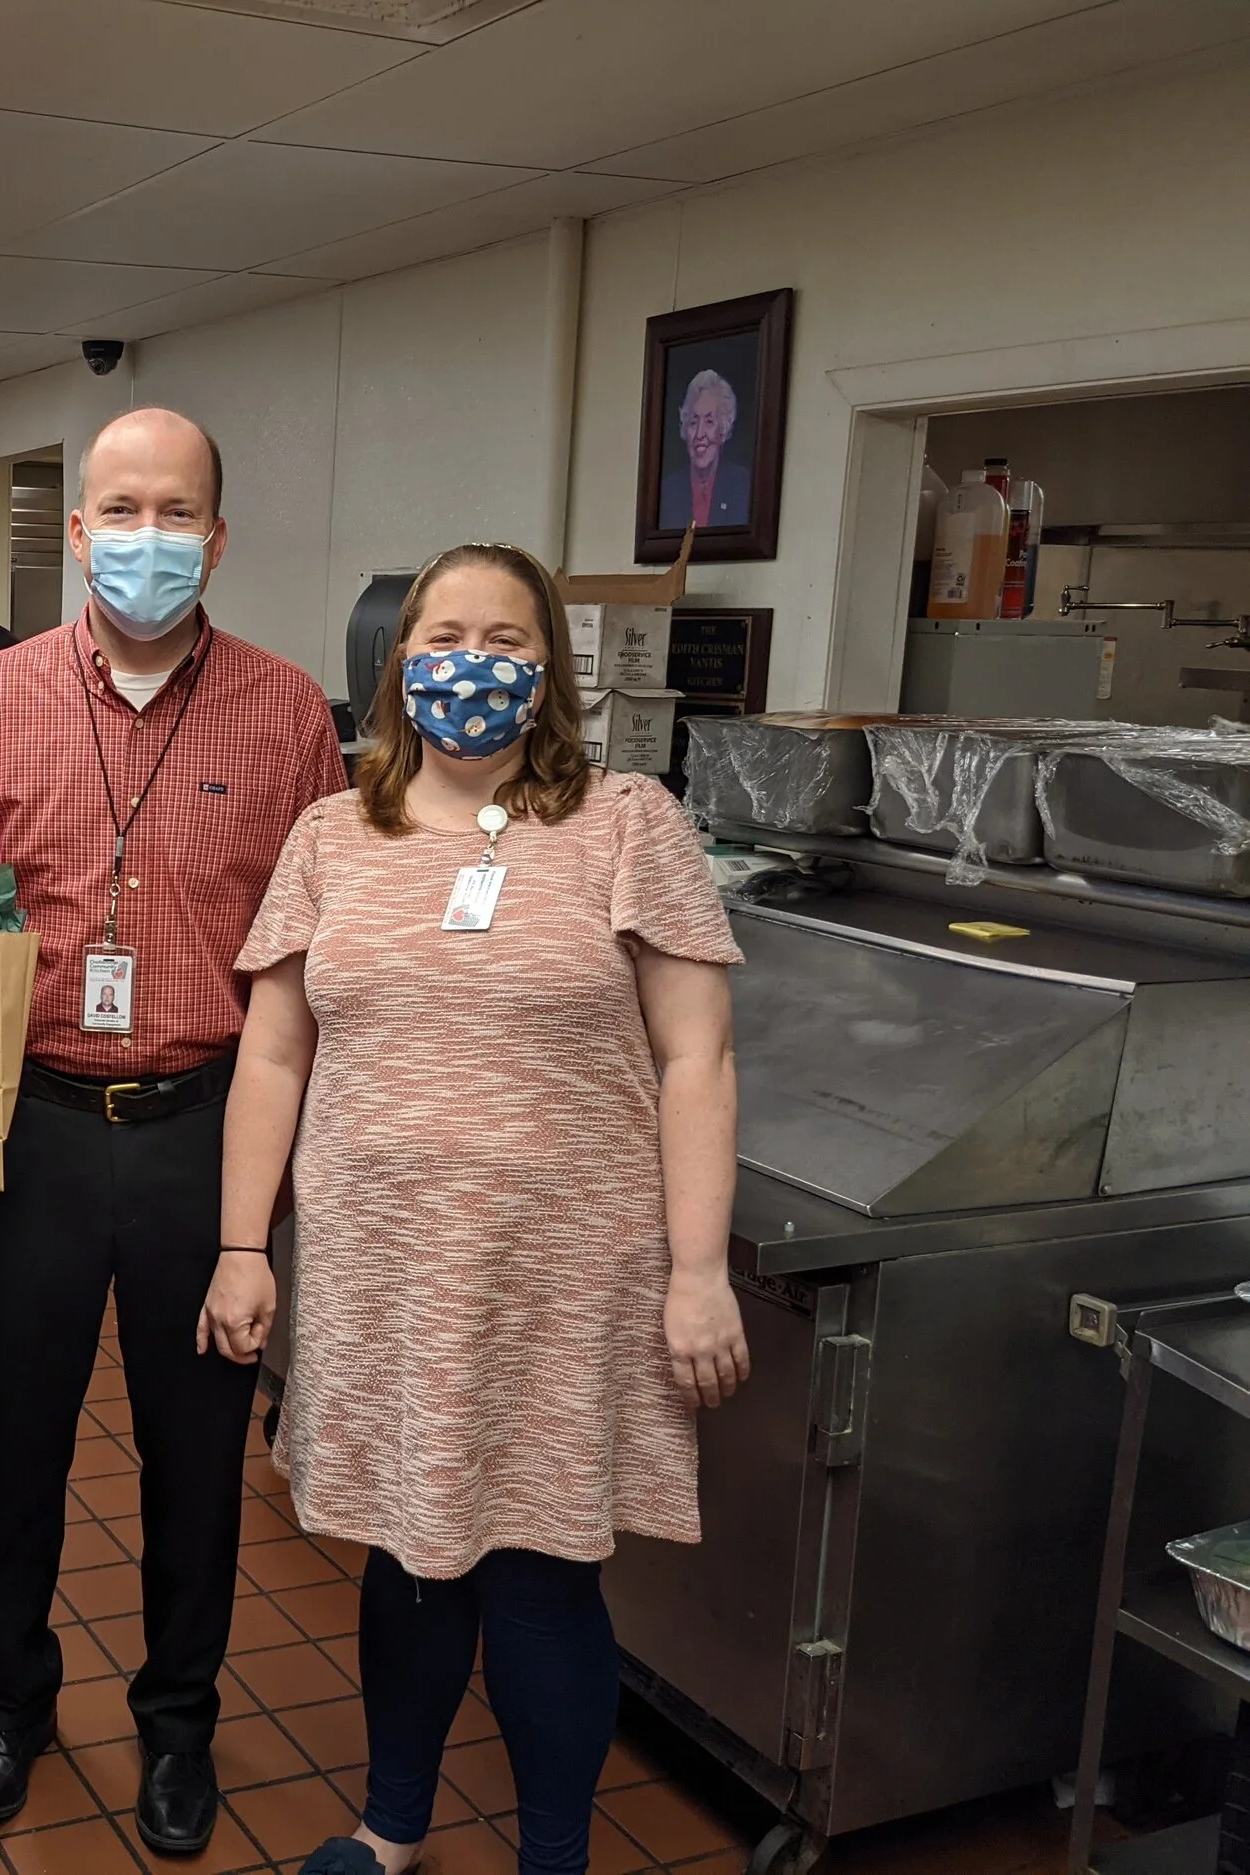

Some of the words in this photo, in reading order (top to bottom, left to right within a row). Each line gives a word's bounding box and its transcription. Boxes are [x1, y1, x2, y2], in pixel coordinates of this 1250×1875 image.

[701, 625, 717, 635] THE
[625, 627, 648, 646] Silver
[618, 651, 652, 659] FOODSERVICE
[687, 677, 724, 687] KITCHEN
[632, 713, 653, 732] Silver
